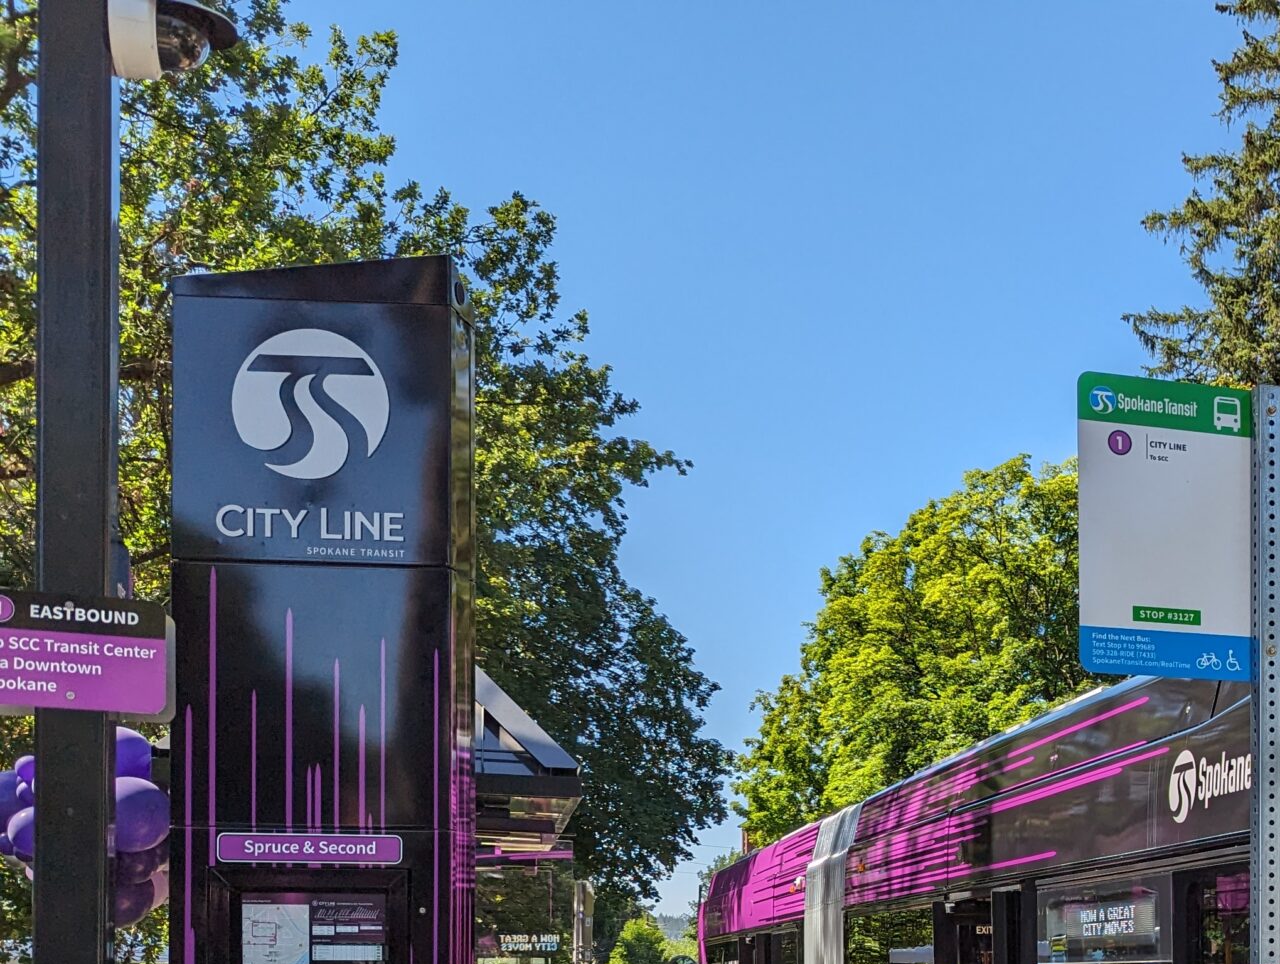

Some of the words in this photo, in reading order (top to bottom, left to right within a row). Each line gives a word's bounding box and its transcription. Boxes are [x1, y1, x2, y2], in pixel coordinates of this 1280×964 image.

[1117, 393, 1163, 413] Spokane
[1164, 398, 1198, 417] Transit
[1116, 435, 1123, 449] 1
[1150, 441, 1167, 449] CITY
[1169, 443, 1187, 452] LINE
[215, 504, 308, 538] CITY
[320, 507, 404, 542] LINE
[306, 546, 356, 556] SPOKANE
[360, 548, 405, 558] TRANSIT
[29, 604, 140, 625] EASTBOUND
[1139, 610, 1165, 620] STOP
[1167, 612, 1195, 621] #3127
[1092, 632, 1106, 640] Find
[1120, 634, 1136, 642] Next
[1136, 635, 1151, 643] Bus:
[1107, 641, 1121, 649] Stop
[8, 636, 40, 651] SCC
[44, 639, 100, 655] Transit
[103, 643, 157, 659] Center
[13, 657, 102, 675] Downtown
[1092, 657, 1191, 669] SpokaneTransit.com/RealTime
[1197, 751, 1251, 808] Spokane
[244, 839, 300, 856] Spruce
[302, 840, 315, 854] &
[318, 841, 376, 855] Second
[1080, 909, 1097, 923] HOW
[1099, 908, 1105, 921] A
[1107, 905, 1136, 920] GREAT
[975, 925, 993, 934] EXIT
[1082, 922, 1102, 936] CITY
[1104, 920, 1134, 935] MOVES
